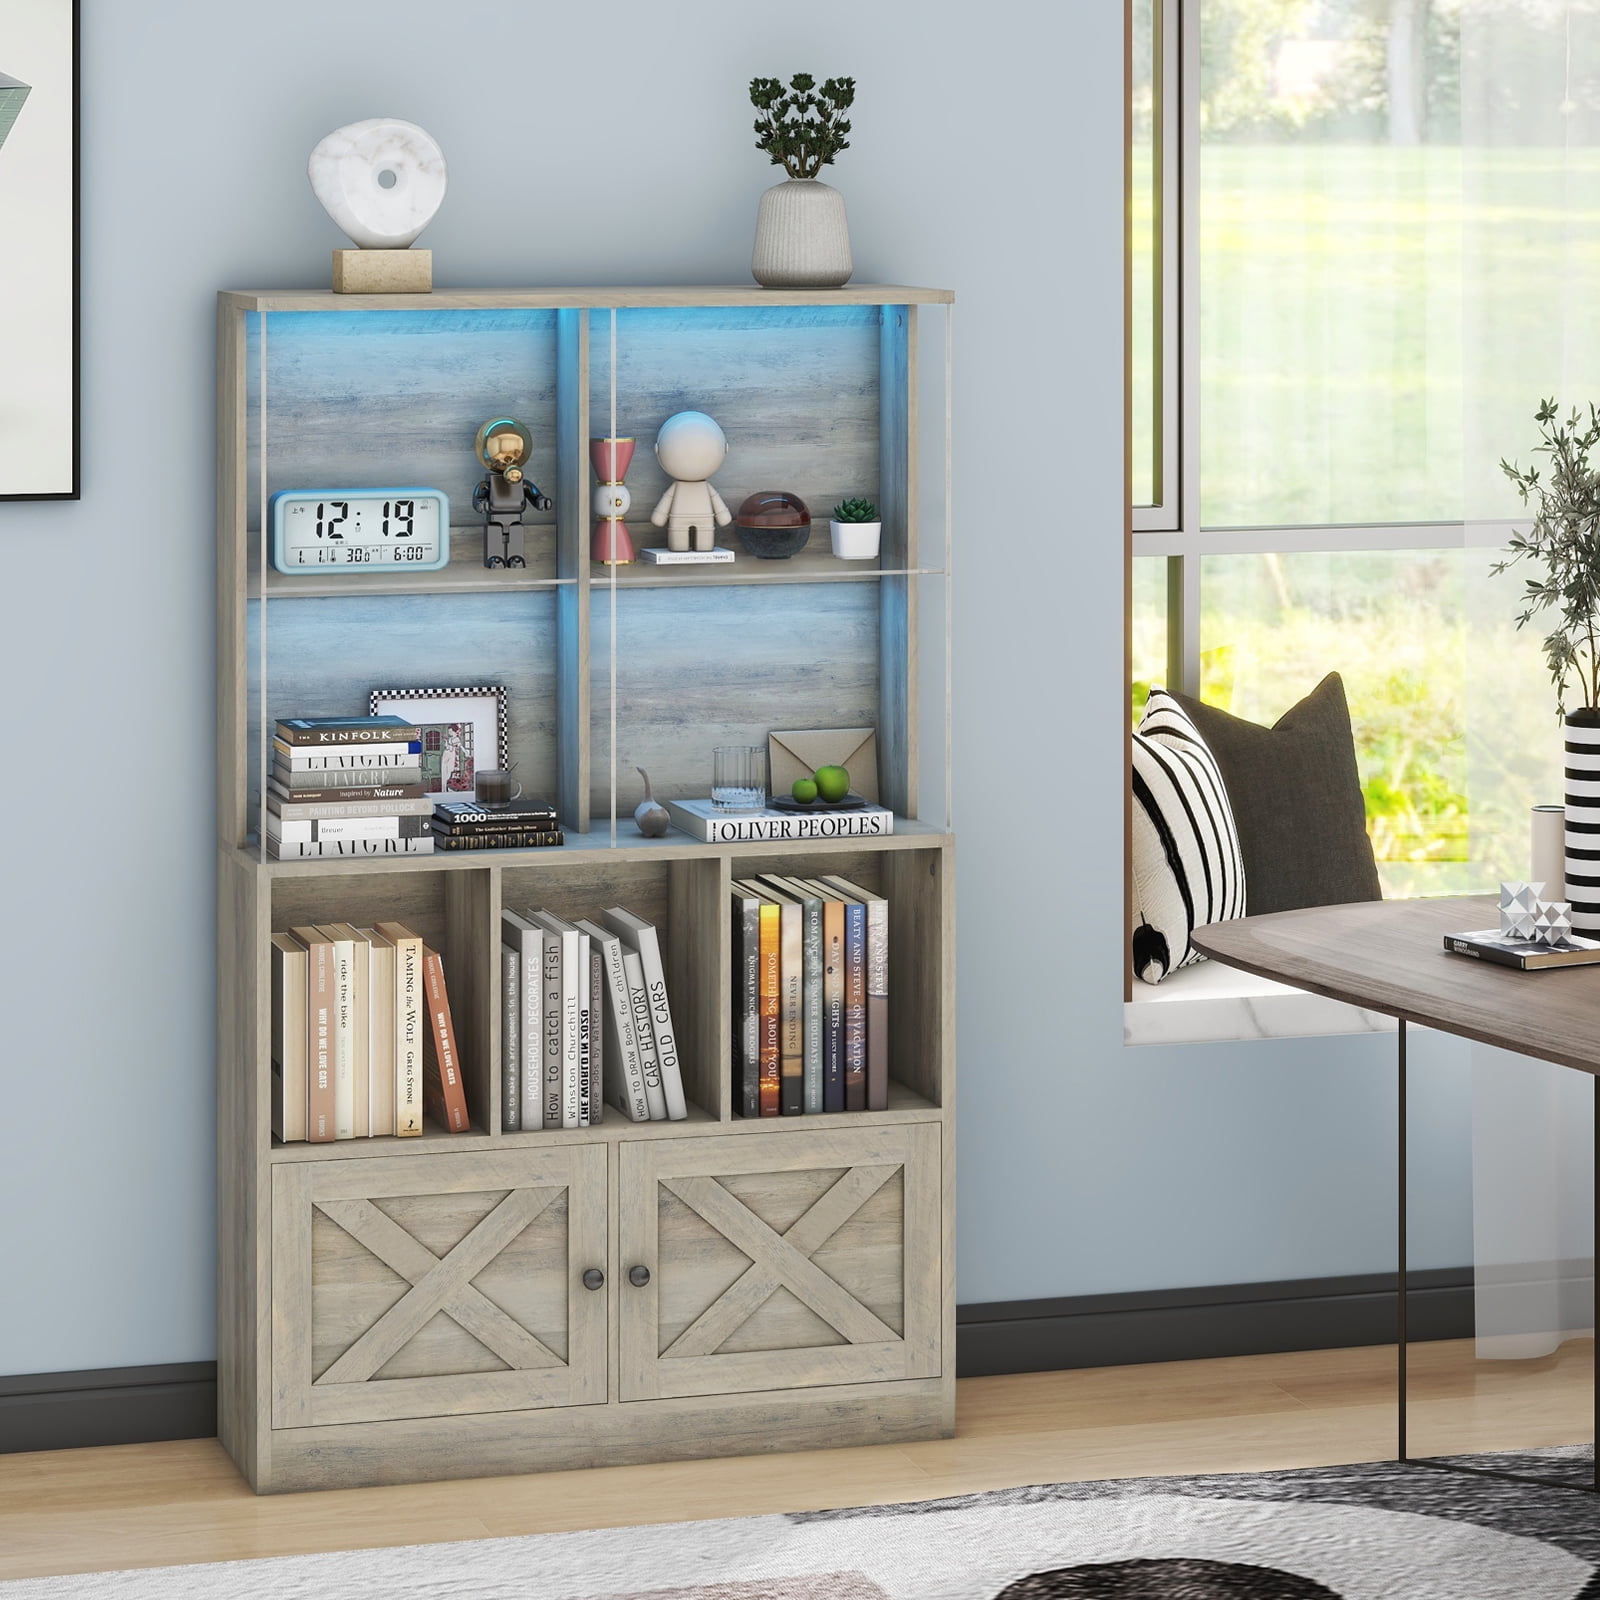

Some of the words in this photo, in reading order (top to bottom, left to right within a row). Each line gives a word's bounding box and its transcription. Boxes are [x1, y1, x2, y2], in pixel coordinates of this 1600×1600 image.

[316, 500, 414, 539] 12:19
[394, 546, 423, 561] 6:00
[319, 730, 392, 742] KINFOLK
[323, 770, 390, 787] LIAIGRE
[373, 788, 403, 797] Nature
[309, 805, 345, 817] PAINTING
[347, 804, 378, 814] BEYOND
[380, 802, 415, 813] POLLOCK
[454, 813, 486, 823] 1000
[721, 820, 791, 841] OLIVER
[798, 815, 880, 837] PEOPLES
[853, 909, 861, 940] BEATY
[810, 911, 818, 962] ROMANCE
[545, 945, 559, 981] fish
[831, 943, 840, 964] DAY
[853, 942, 861, 963] AND
[340, 959, 348, 981] ride
[406, 945, 416, 993] TAMING
[508, 956, 516, 979] house
[592, 956, 600, 1001] Isaacson
[610, 944, 624, 993] children
[831, 966, 840, 988] AND
[508, 982, 516, 995] the
[527, 957, 539, 1025] DECORATES
[768, 952, 777, 1014] SOMETHING
[789, 975, 797, 1007] NEVER
[853, 966, 861, 996] STEVE
[340, 984, 348, 1002] the
[508, 999, 516, 1009] in
[548, 992, 559, 1001] a
[650, 981, 669, 1024] CARS
[318, 1008, 327, 1025] WHY
[340, 1005, 348, 1029] bike
[619, 999, 628, 1016] for
[748, 996, 756, 1034] NICHOLAS
[831, 991, 840, 1028] NIGHTS
[853, 1004, 861, 1019] ON
[406, 1010, 416, 1044] WOLF
[437, 1012, 446, 1028] WHY
[567, 996, 576, 1061] Churchill
[592, 1008, 600, 1043] Walter
[631, 987, 654, 1052] HISTORY
[789, 1010, 797, 1049] ENDING
[318, 1026, 327, 1037] DO
[440, 1028, 448, 1039] DO
[545, 1010, 559, 1056] catch
[622, 1021, 633, 1046] Book
[768, 1017, 777, 1051] ABOUT
[318, 1038, 327, 1050] WE
[441, 1039, 450, 1051] WE
[592, 1047, 601, 1059] by
[660, 1034, 677, 1067] OLD
[853, 1021, 861, 1074] VACATION
[318, 1051, 327, 1069] LOVE
[406, 1051, 415, 1076] GREG
[444, 1051, 453, 1068] LOVE
[509, 1063, 516, 1073] an
[527, 1032, 539, 1100] HOUSEHOLD
[628, 1051, 639, 1076] DRAW
[768, 1054, 777, 1077] YOU
[318, 1070, 327, 1089] CATS
[447, 1067, 456, 1086] CATS
[546, 1065, 559, 1084] to
[592, 1063, 600, 1086] Jobs
[644, 1059, 660, 1088] CAR
[406, 1077, 415, 1105] STONE
[567, 1067, 576, 1119] Winston
[633, 1080, 641, 1093] TO
[508, 1097, 516, 1107] to
[546, 1093, 559, 1121] How
[635, 1098, 646, 1118] HOW
[508, 1110, 516, 1125] How
